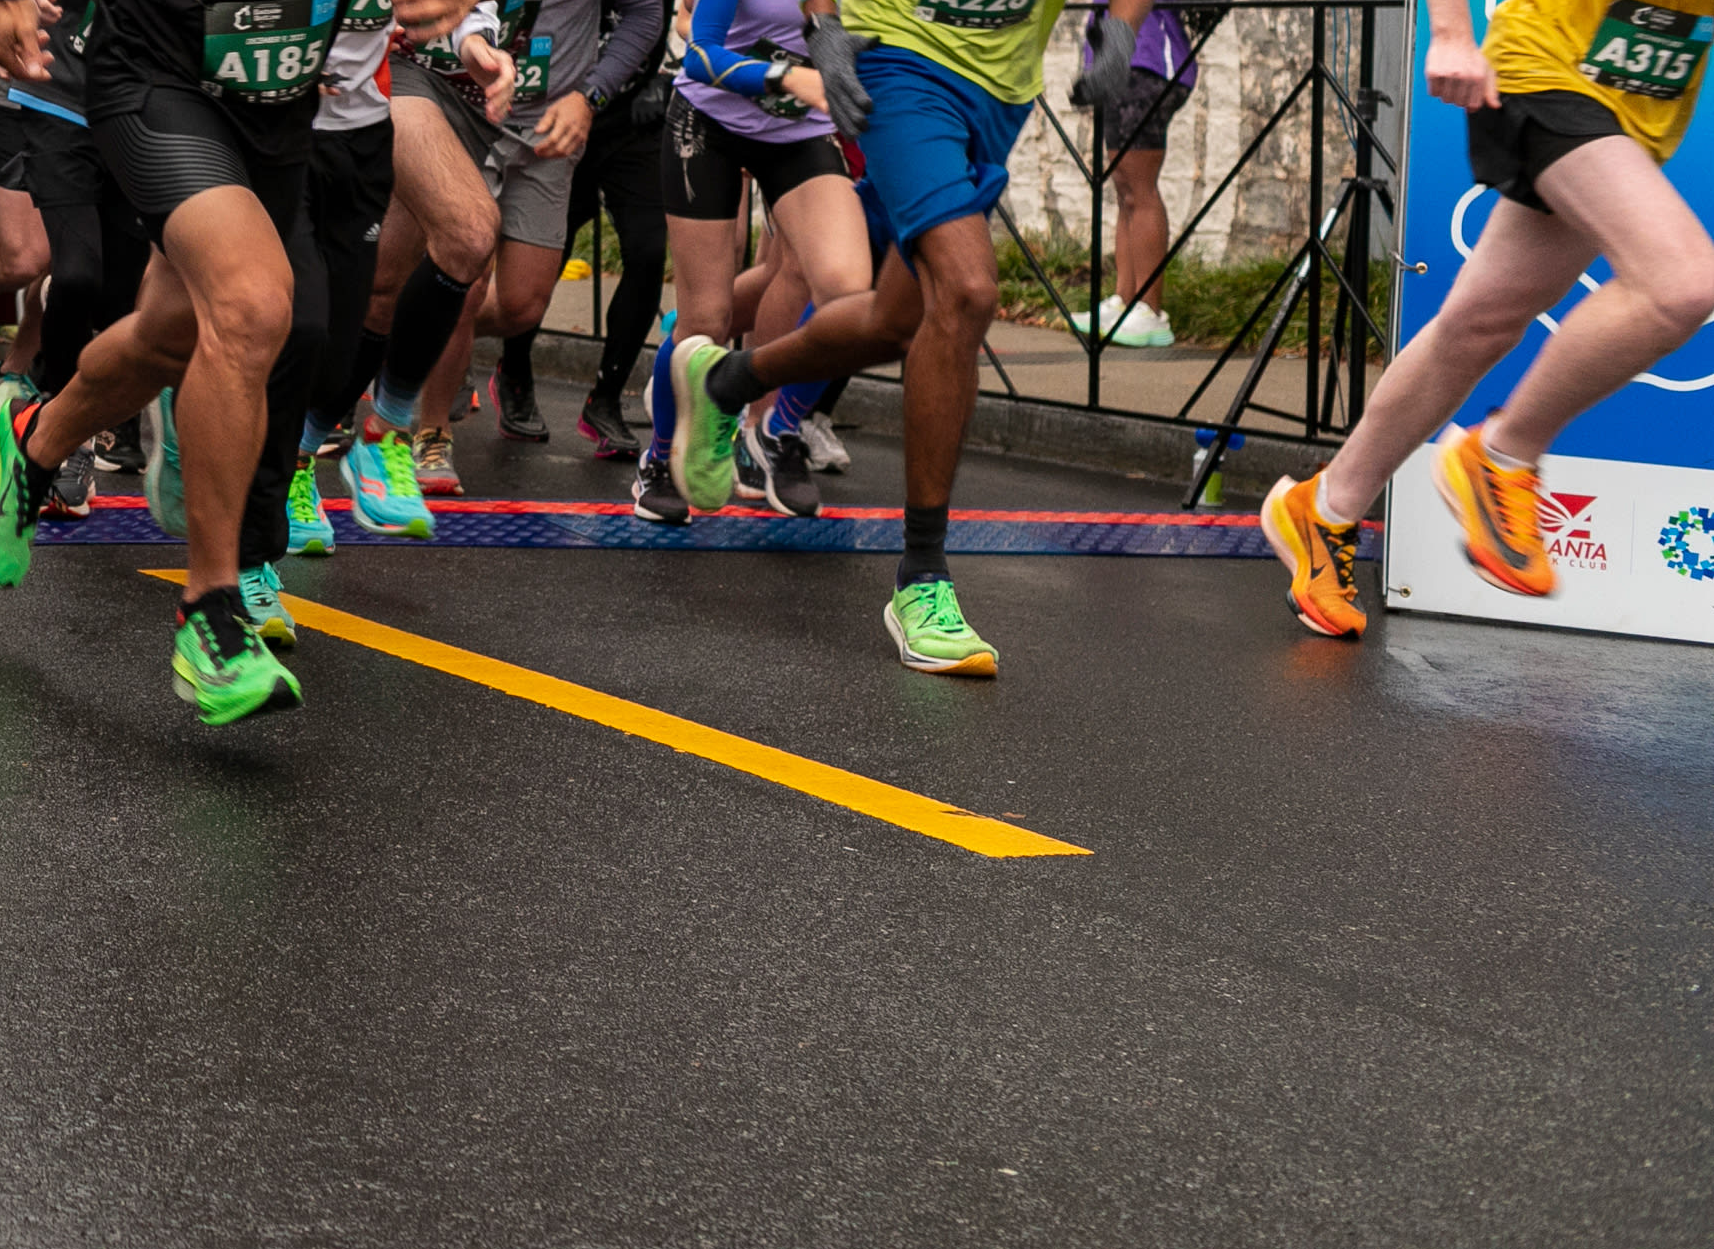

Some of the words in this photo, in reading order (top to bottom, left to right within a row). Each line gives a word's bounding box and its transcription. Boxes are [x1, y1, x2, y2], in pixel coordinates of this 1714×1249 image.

[214, 40, 324, 83] A185
[1592, 36, 1696, 80] A315
[1569, 559, 1607, 571] CLUB
